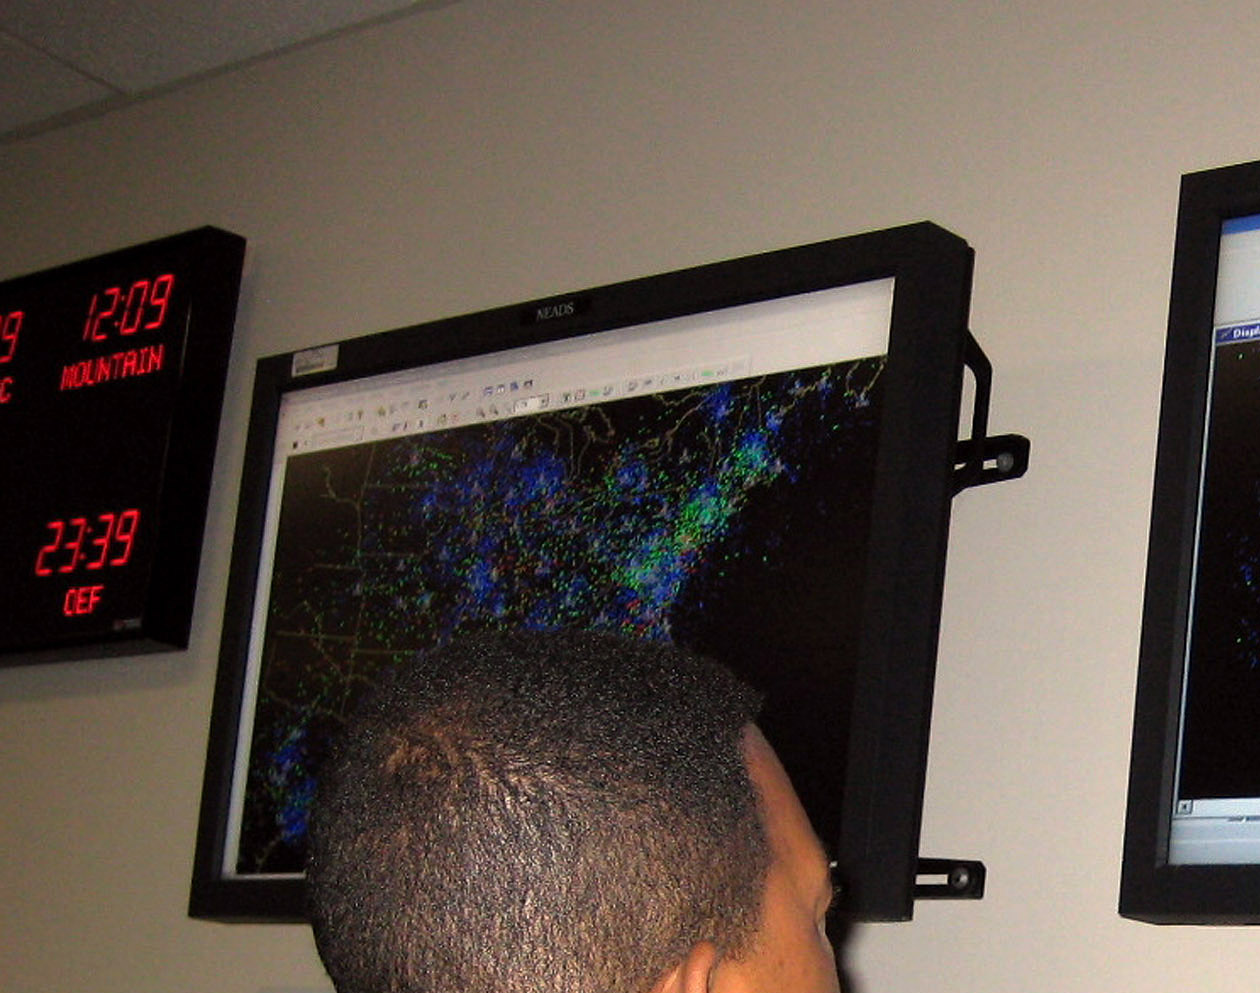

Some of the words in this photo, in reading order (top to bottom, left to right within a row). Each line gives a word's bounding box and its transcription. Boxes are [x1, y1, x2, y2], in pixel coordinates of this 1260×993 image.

[84, 274, 175, 341] 12:09
[536, 302, 574, 321] NEADS
[60, 345, 164, 390] MOUNTAIN
[36, 509, 140, 576] 23:39
